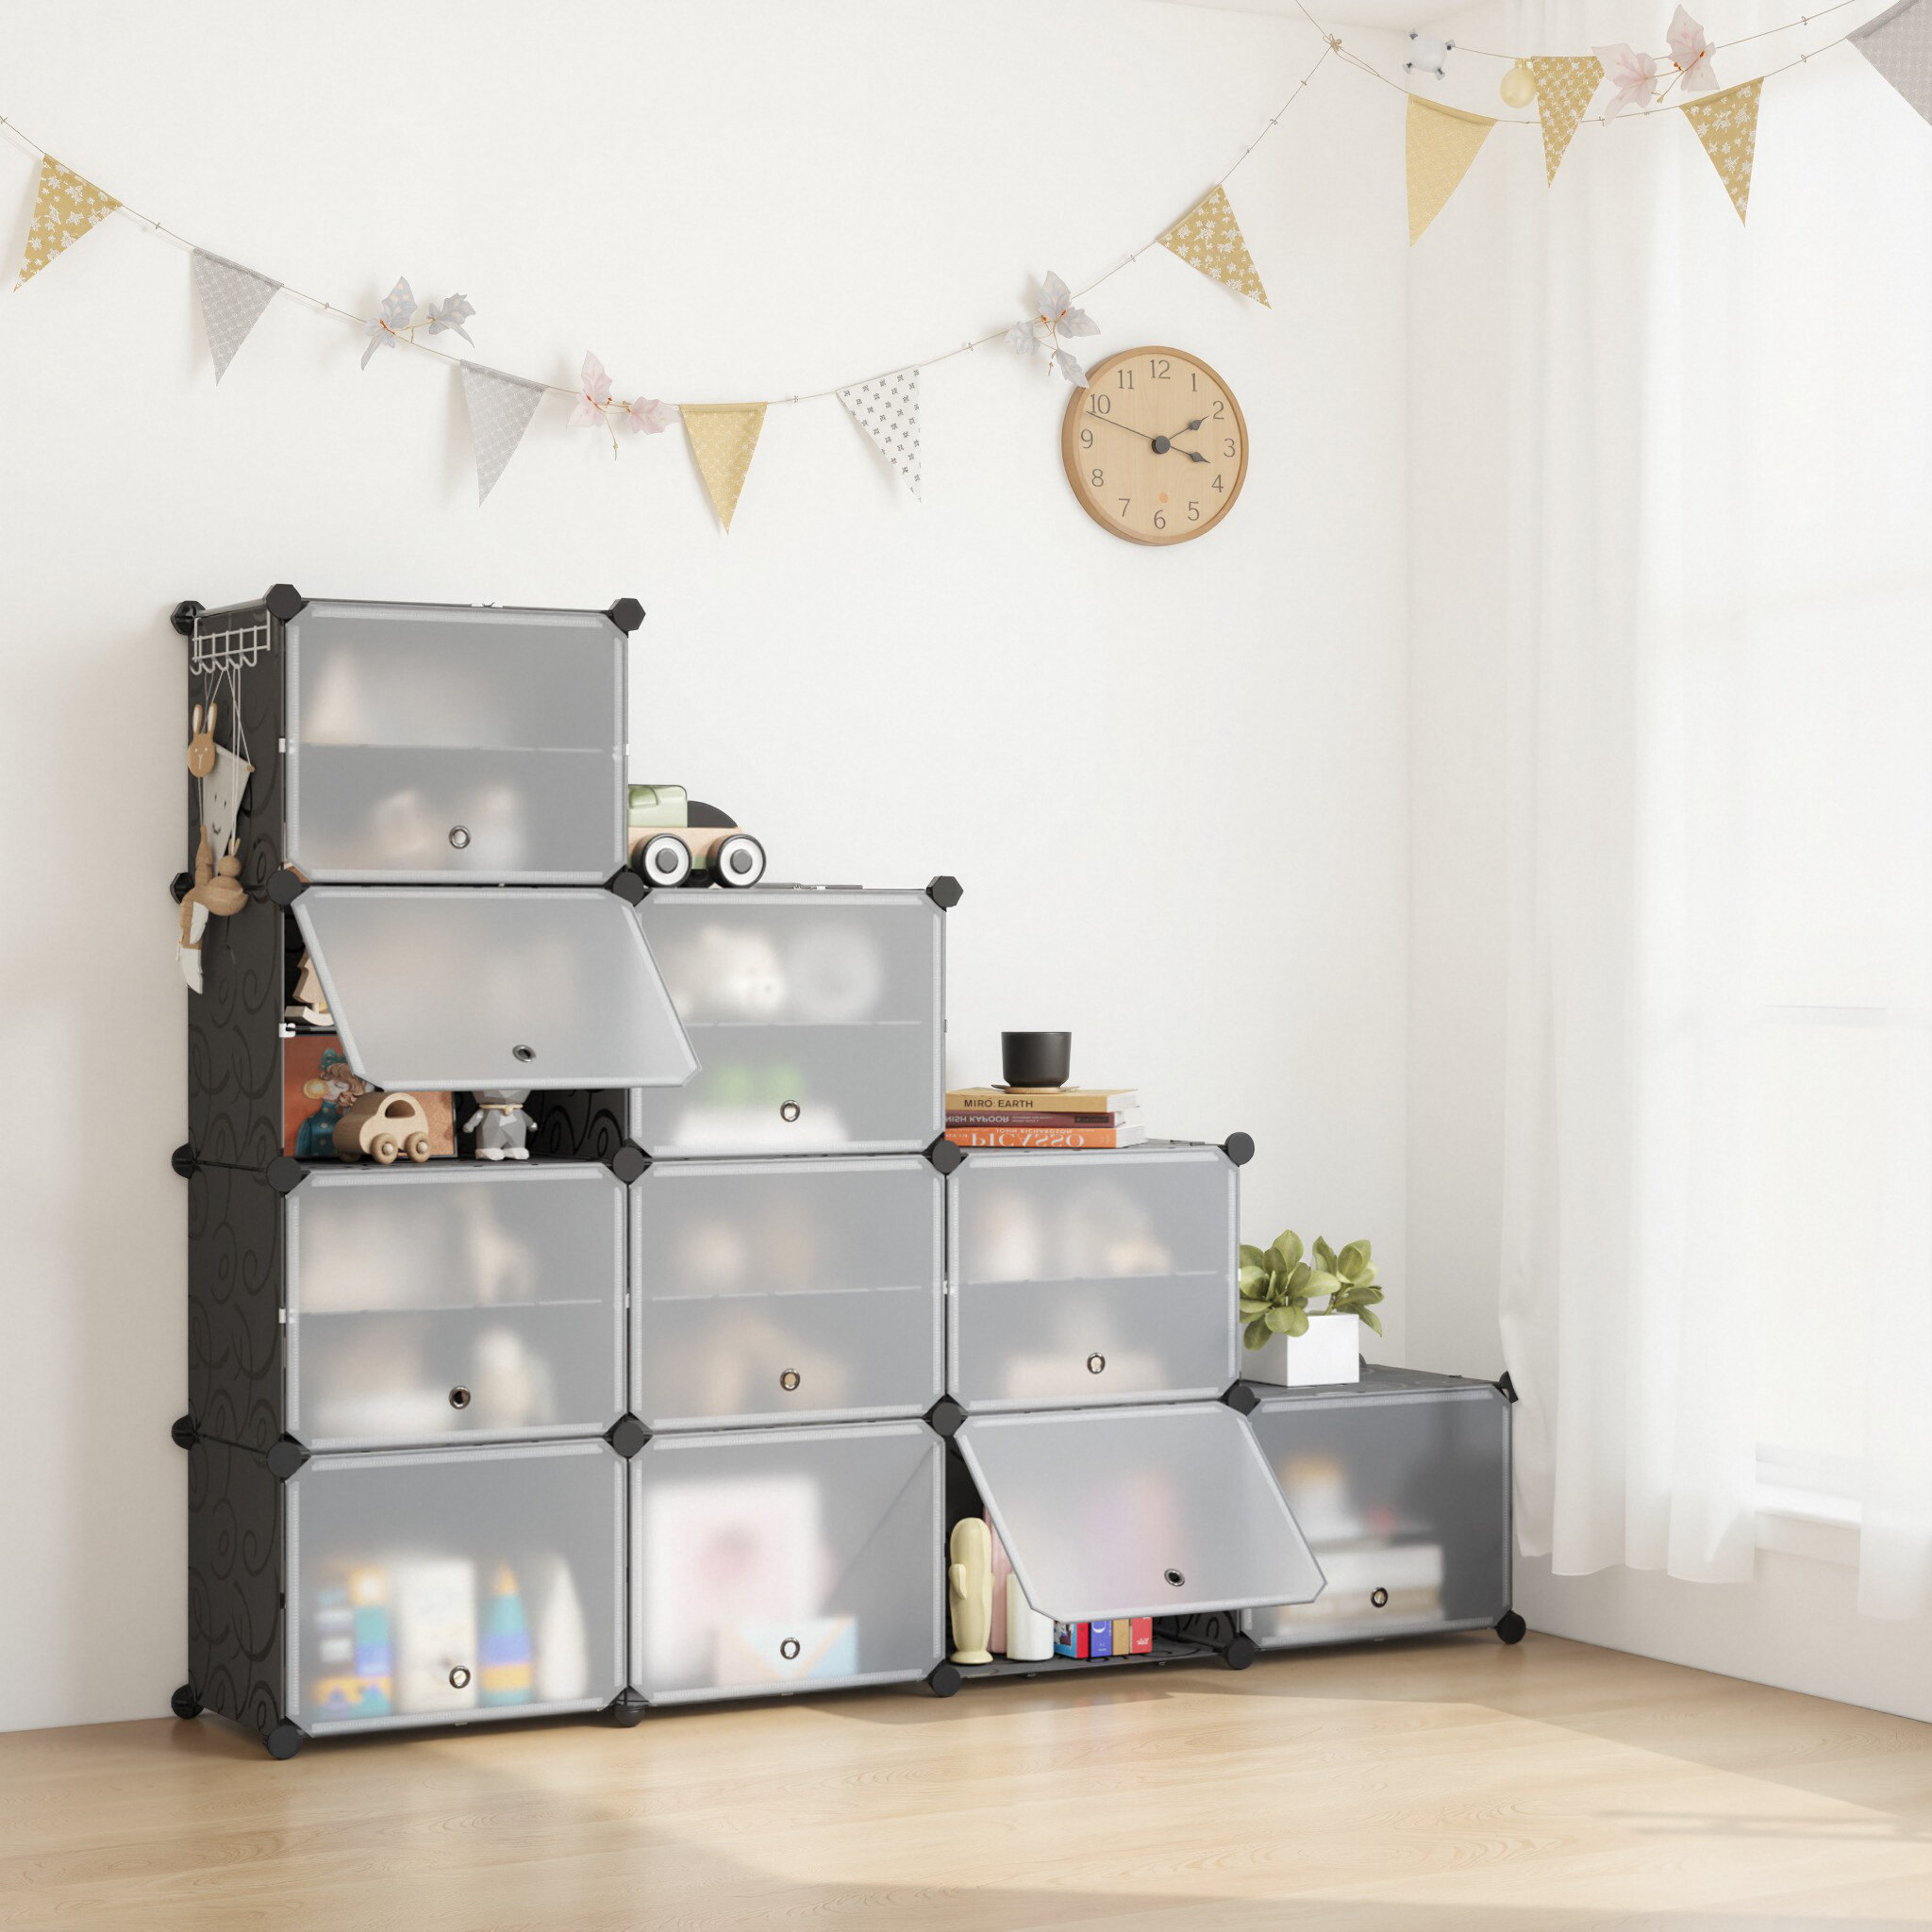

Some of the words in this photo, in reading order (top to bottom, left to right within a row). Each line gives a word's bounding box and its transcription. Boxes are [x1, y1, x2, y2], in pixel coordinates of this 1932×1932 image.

[1149, 358, 1171, 380] 12
[1117, 369, 1135, 390] 11
[1191, 373, 1198, 392] 1
[1090, 393, 1111, 415] 10
[1212, 400, 1224, 420] 2
[1080, 428, 1094, 449] 9
[1223, 438, 1236, 458] 3
[1091, 469, 1105, 488] 8
[1211, 474, 1224, 493] 4
[1118, 497, 1131, 518] 7
[1187, 501, 1200, 522] 5
[1153, 509, 1166, 529] 6
[998, 1099, 1033, 1108] EARTH
